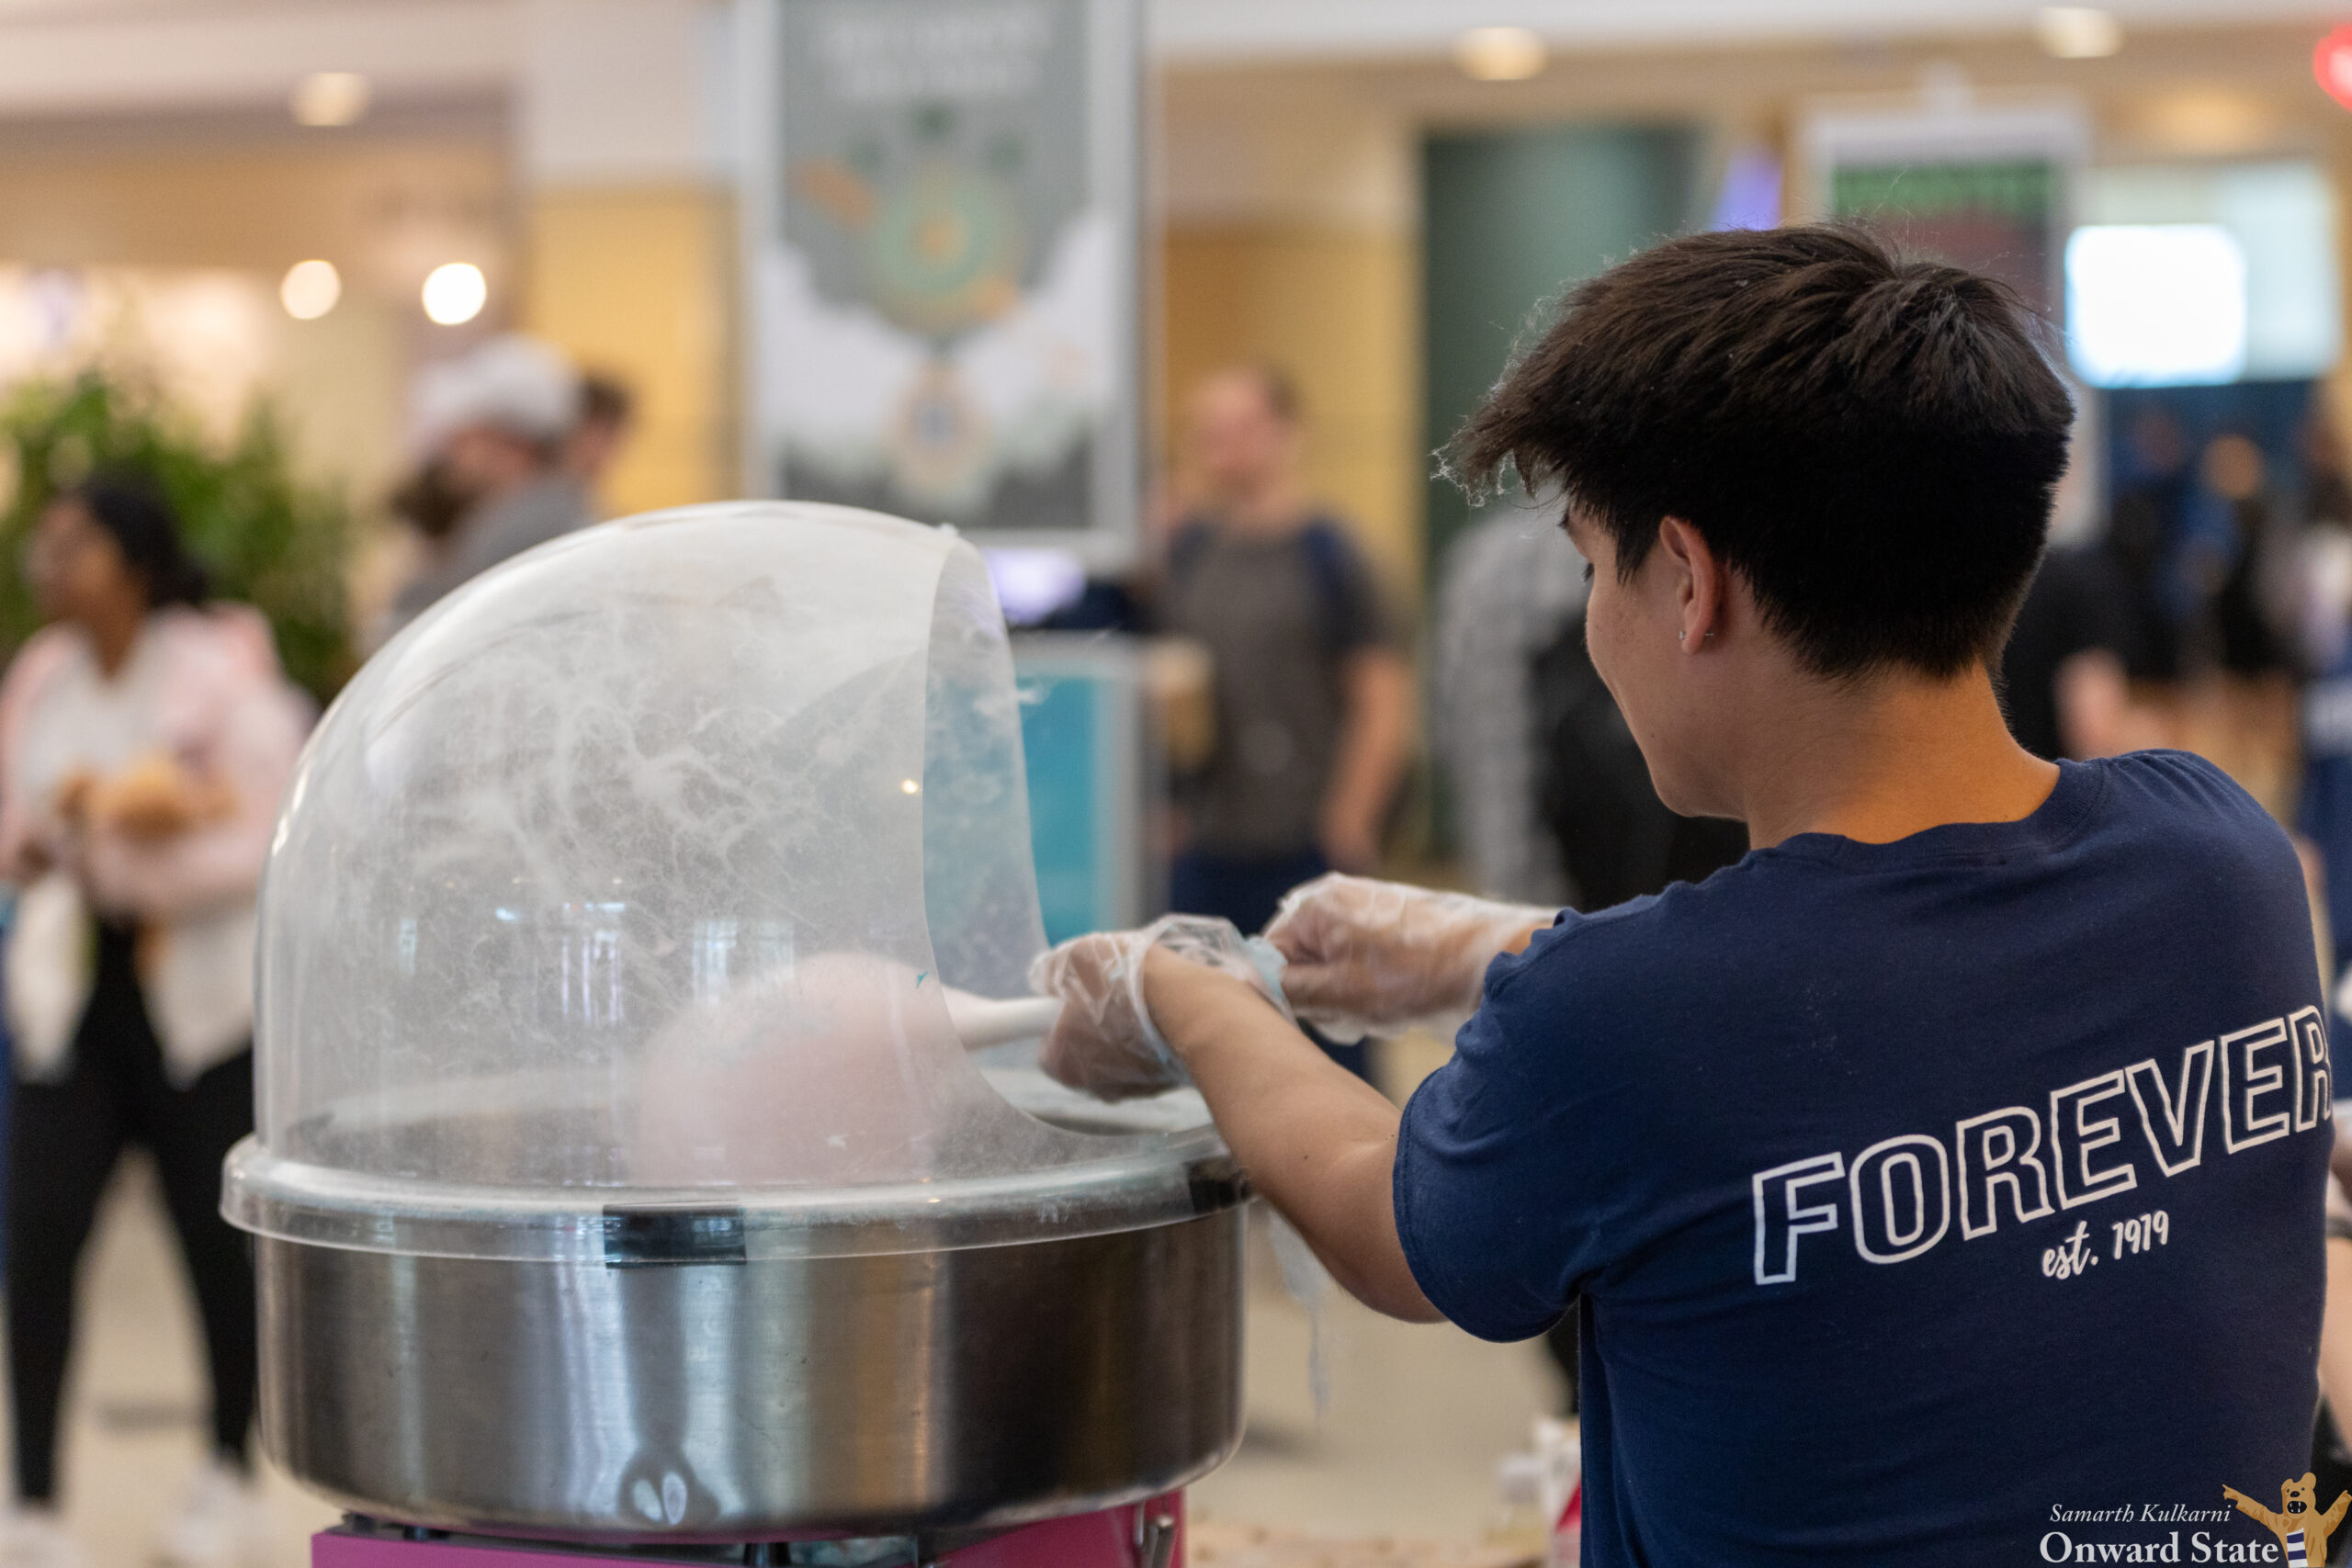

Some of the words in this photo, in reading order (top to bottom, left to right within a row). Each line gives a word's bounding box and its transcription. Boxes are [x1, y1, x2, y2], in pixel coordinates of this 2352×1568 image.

[1753, 1005, 2332, 1284] FOREVER
[2042, 1221, 2098, 1280] est.
[2112, 1210, 2169, 1259] 1919
